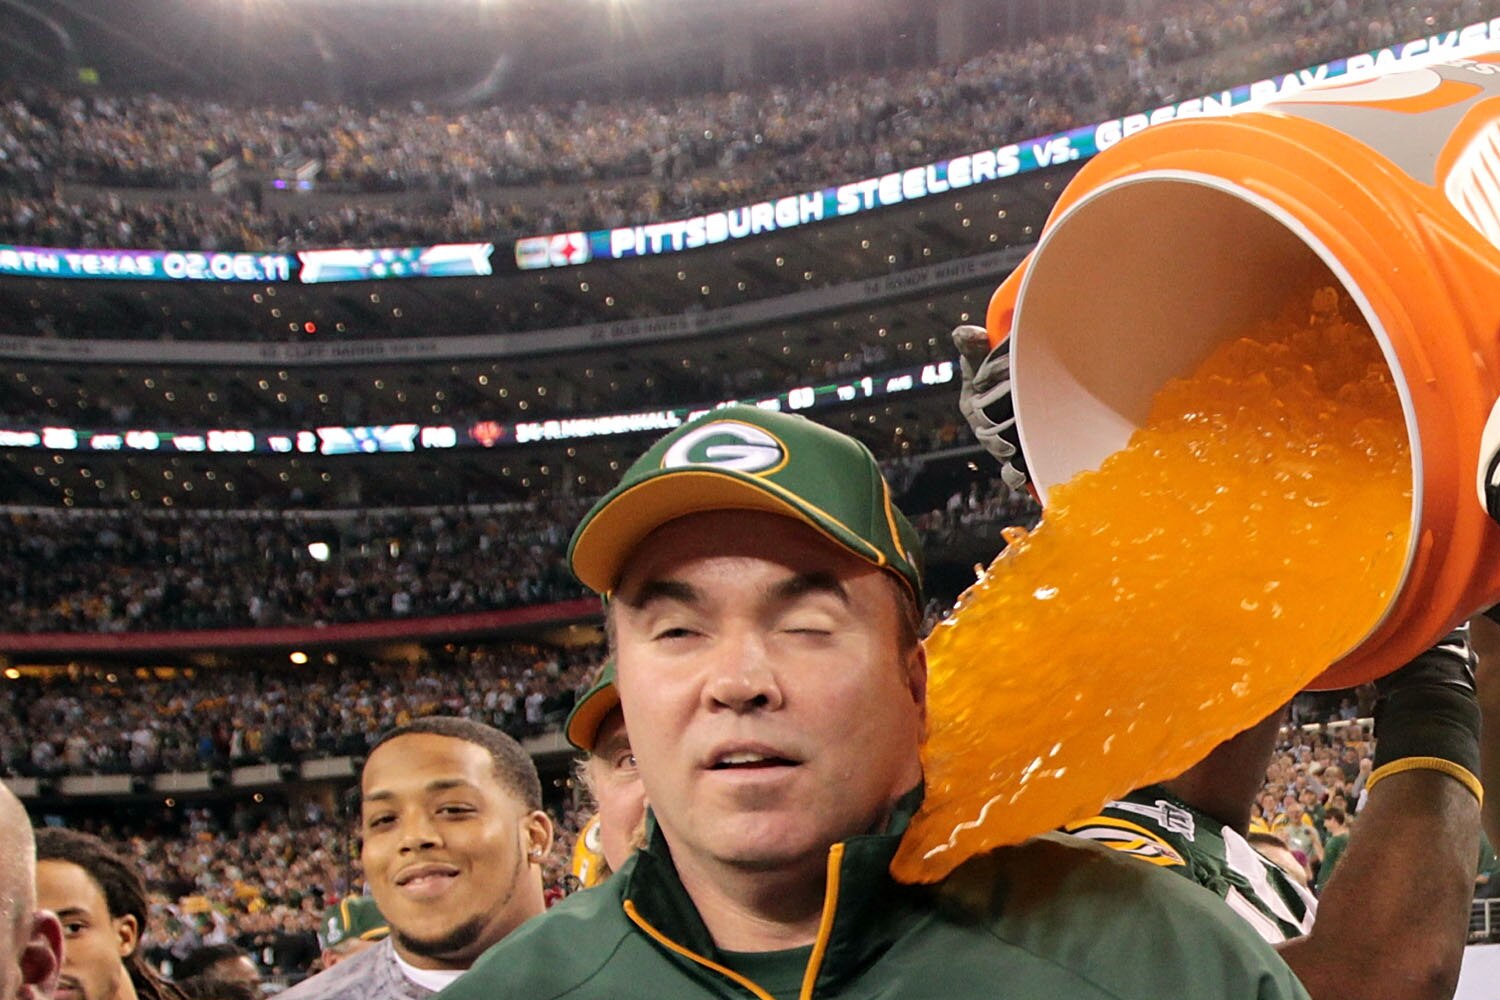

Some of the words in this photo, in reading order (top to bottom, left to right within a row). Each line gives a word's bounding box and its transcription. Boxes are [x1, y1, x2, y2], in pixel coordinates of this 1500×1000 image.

[610, 191, 824, 258] PITTSBURGH
[837, 144, 1020, 216] STEELERS
[1032, 136, 1080, 168] VS.
[65, 253, 156, 276] TEXAS
[162, 252, 291, 281] 02.06.11
[664, 421, 782, 472] G
